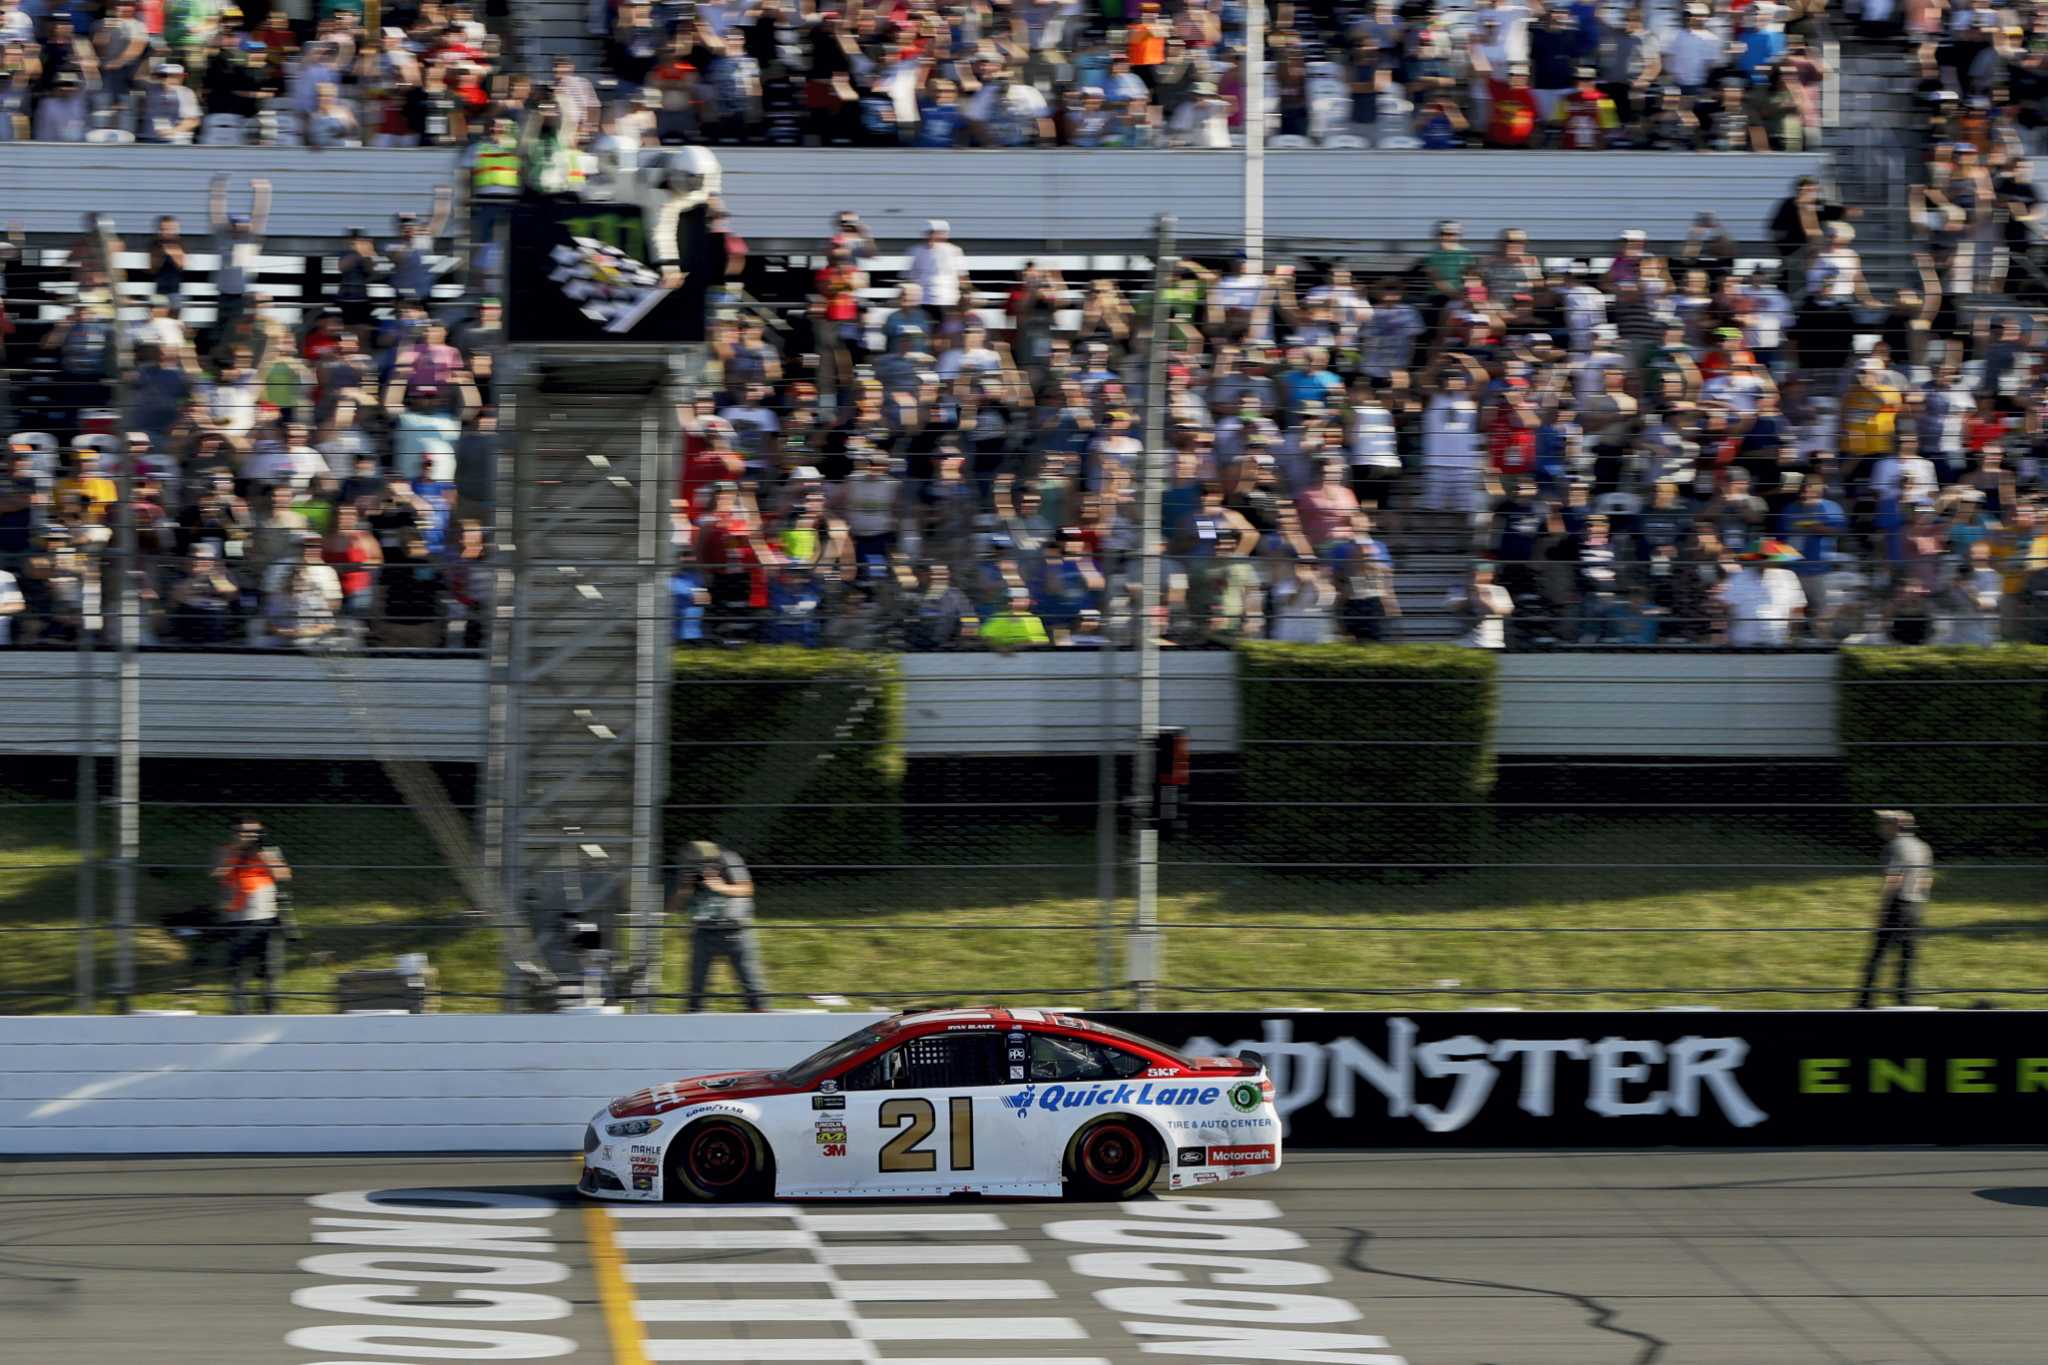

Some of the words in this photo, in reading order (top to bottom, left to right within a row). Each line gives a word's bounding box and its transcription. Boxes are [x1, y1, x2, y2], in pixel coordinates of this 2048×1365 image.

[1147, 1068, 1180, 1077] SKF
[1799, 1058, 2048, 1093] ENER
[1039, 1084, 1135, 1111] Quick
[1136, 1082, 1220, 1106] Lane
[1167, 1120, 1190, 1129] TIRE
[1191, 1120, 1198, 1129] &
[1200, 1119, 1229, 1129] AUTO
[1230, 1118, 1272, 1128] CENTER
[879, 1096, 975, 1173] 21
[631, 1145, 662, 1155] MAHLE
[823, 1144, 846, 1157] 3M
[1212, 1148, 1271, 1161] Motorcraft
[284, 1188, 584, 1365] OCONO
